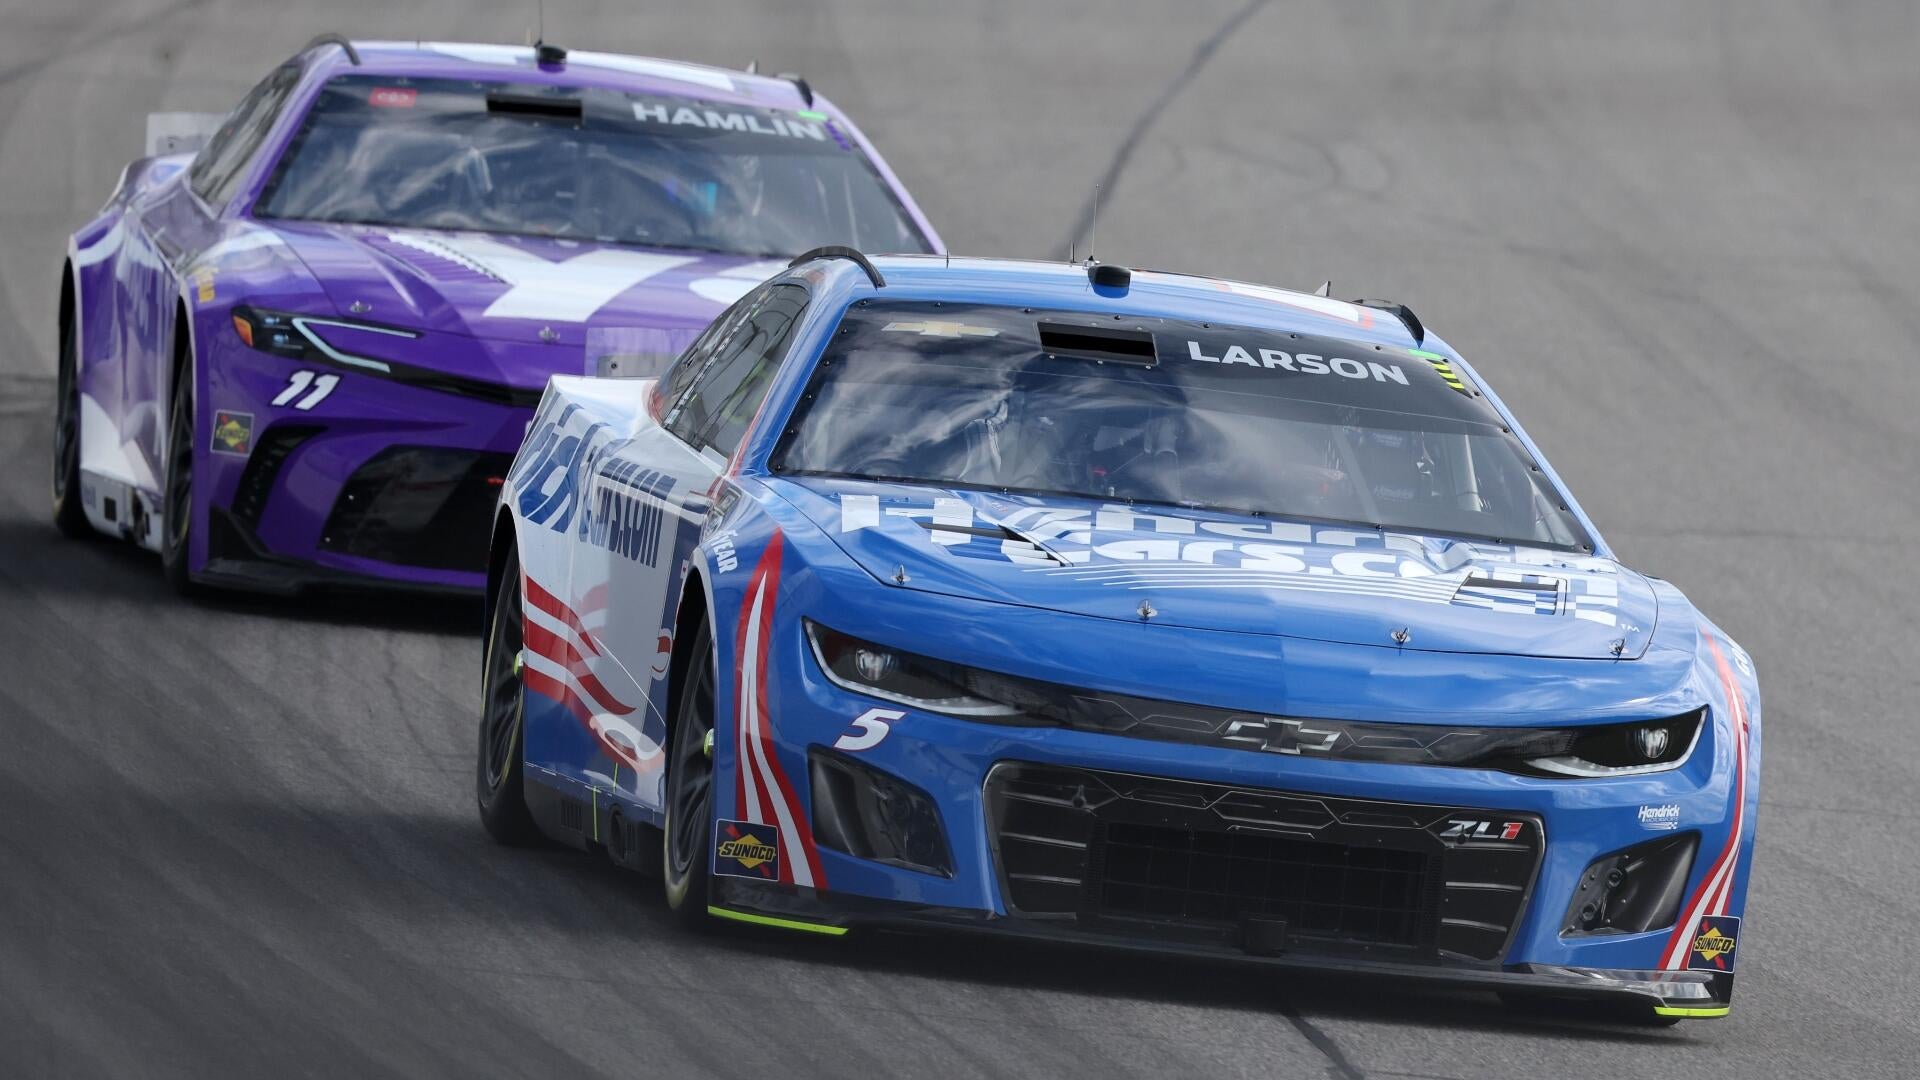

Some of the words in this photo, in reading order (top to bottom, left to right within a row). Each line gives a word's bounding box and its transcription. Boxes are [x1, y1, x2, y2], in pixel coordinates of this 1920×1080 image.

[632, 103, 826, 141] HAMLIN
[1187, 341, 1411, 386] LARSON
[271, 369, 341, 411] 11
[833, 707, 907, 751] 5
[1637, 804, 1681, 822] Hendrick
[1439, 819, 1524, 841] ZL1
[720, 842, 775, 861] SUNOCO
[1694, 936, 1732, 952] SUNOCO
